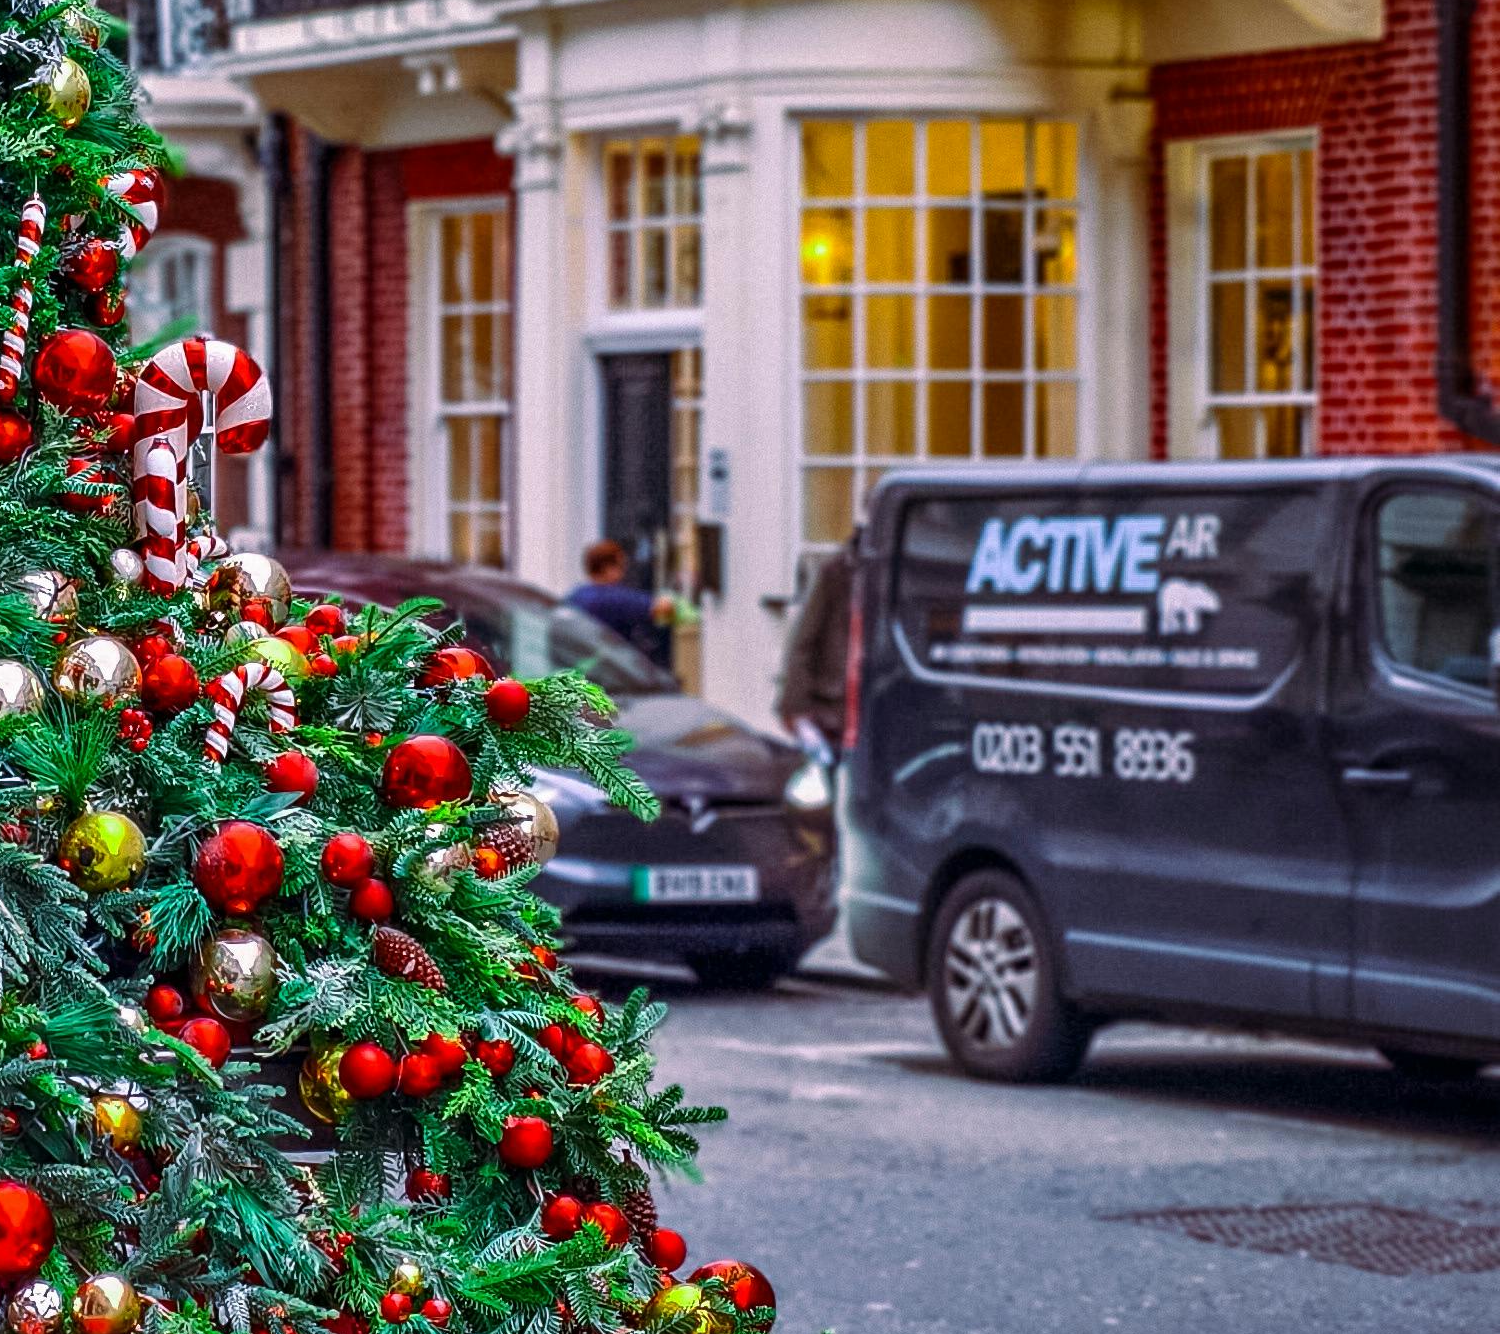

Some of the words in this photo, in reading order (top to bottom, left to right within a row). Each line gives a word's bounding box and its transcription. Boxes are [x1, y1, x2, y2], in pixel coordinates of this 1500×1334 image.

[965, 514, 1166, 593] ACTIVE
[972, 723, 1044, 774] 0203
[1053, 724, 1101, 778] 551
[1113, 728, 1196, 784] 8936
